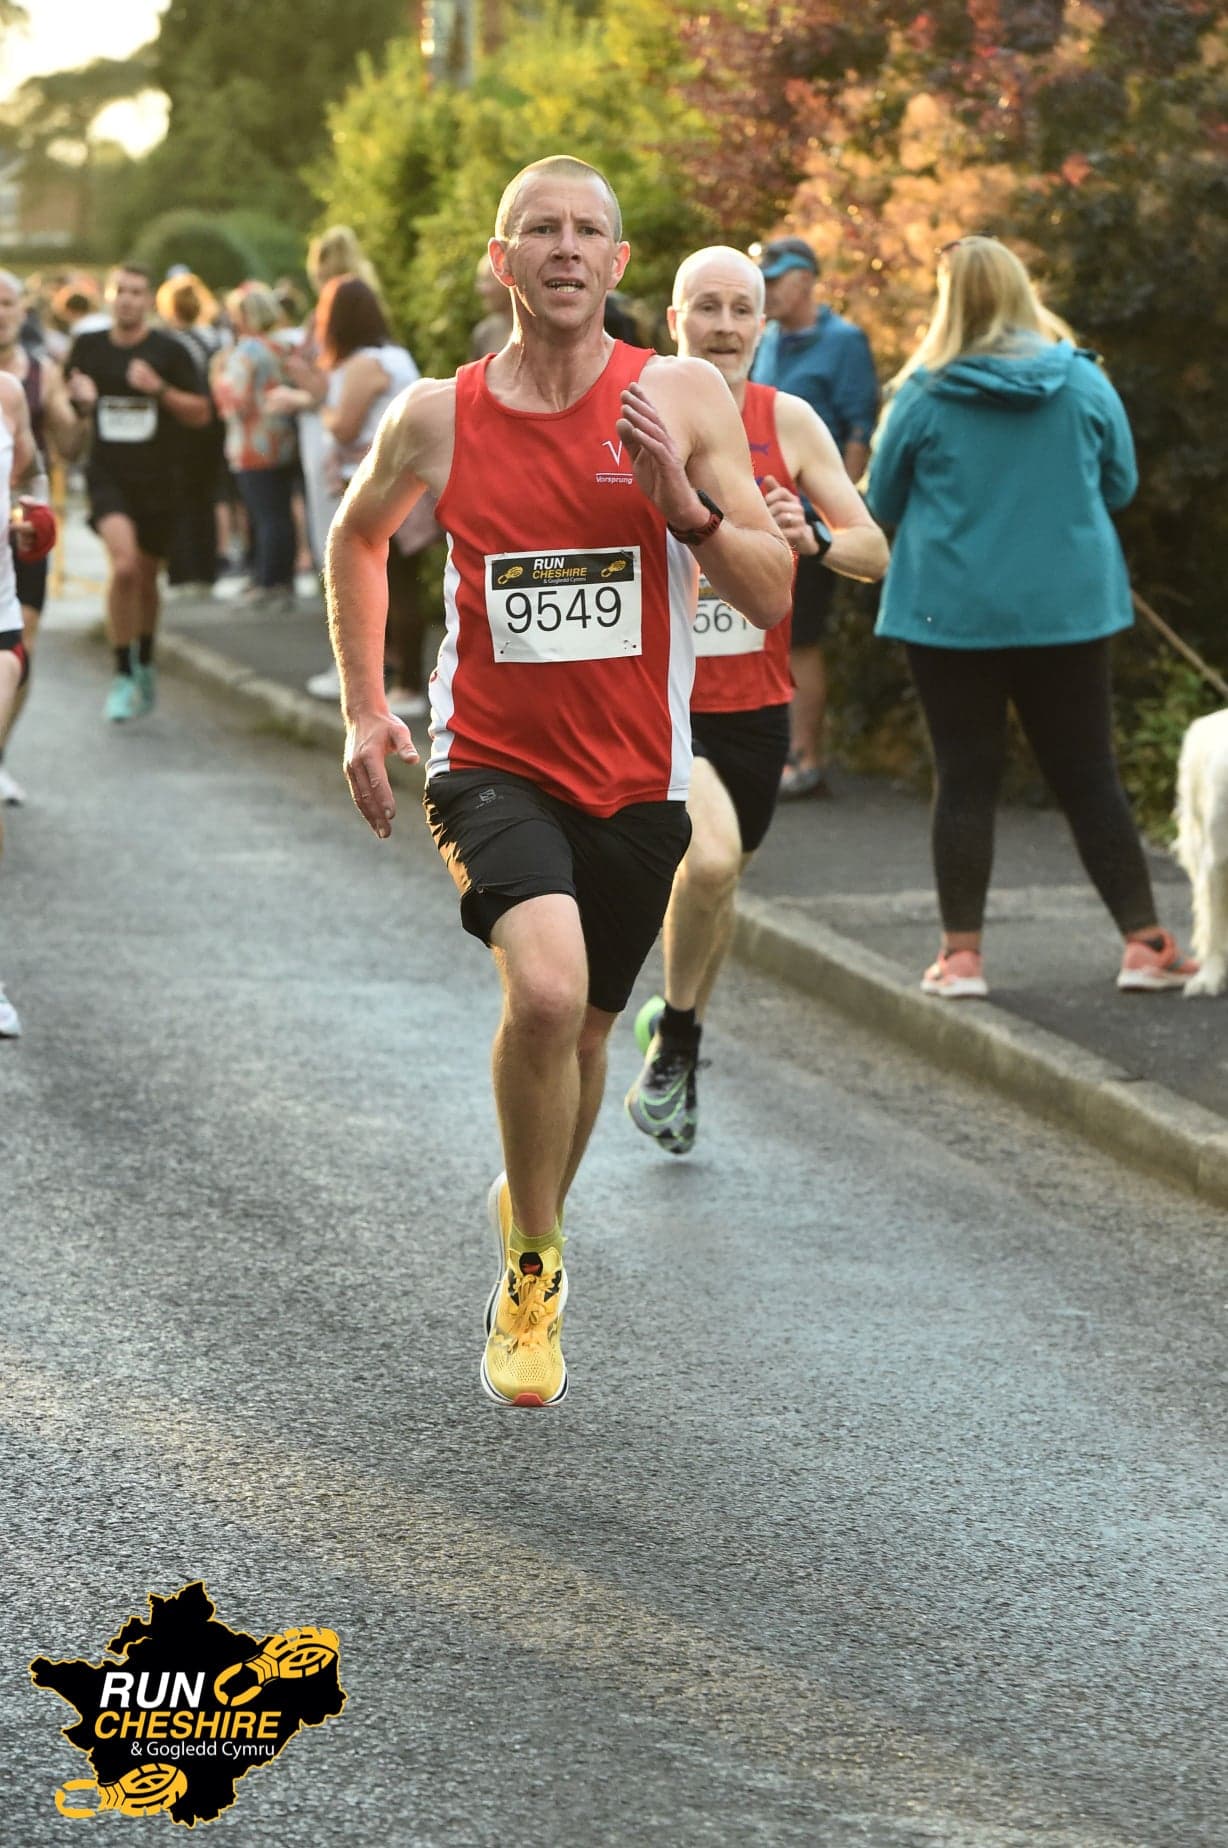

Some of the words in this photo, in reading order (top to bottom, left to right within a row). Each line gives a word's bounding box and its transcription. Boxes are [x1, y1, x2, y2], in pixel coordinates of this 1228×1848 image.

[533, 557, 565, 570] RUN
[532, 567, 588, 580] CHESHIRE
[505, 586, 622, 634] 9549
